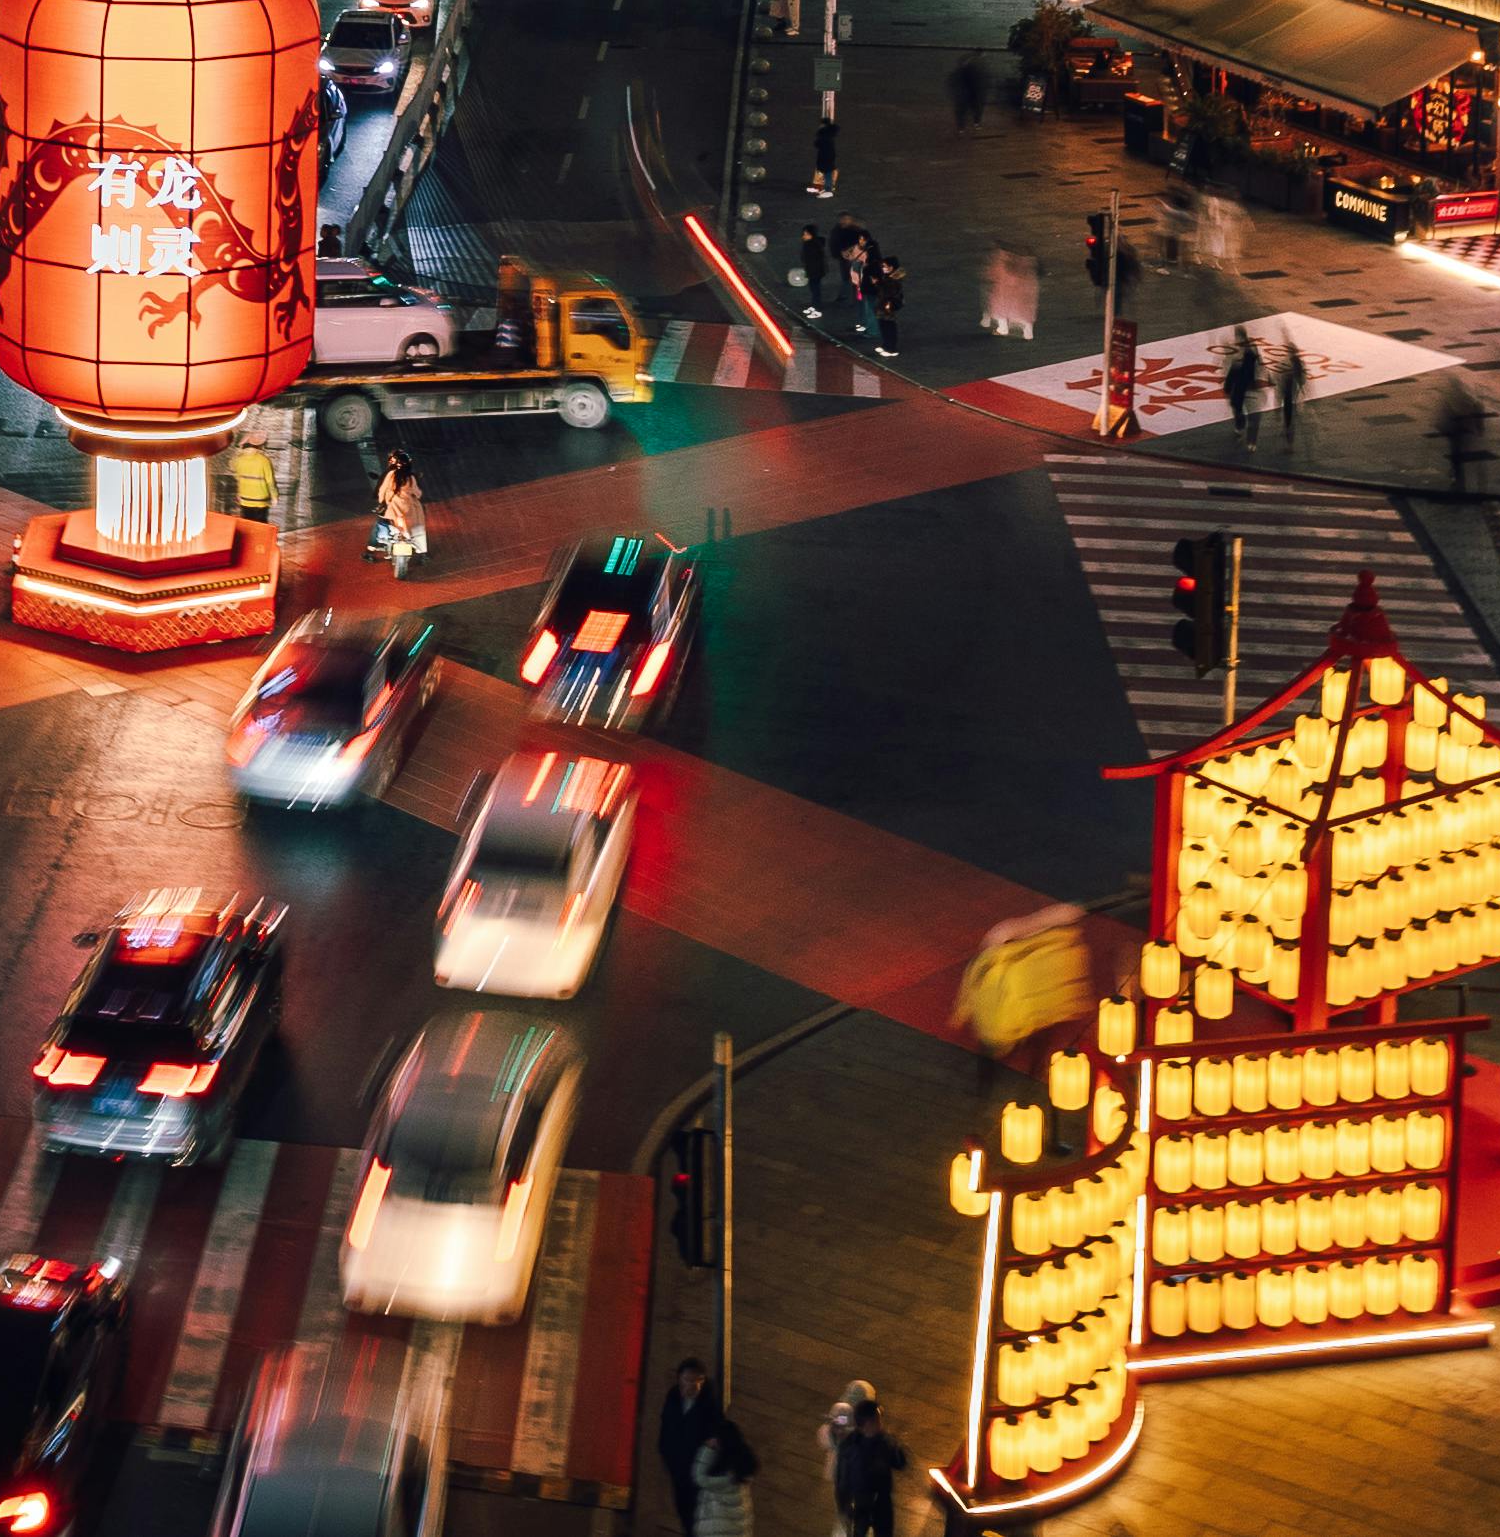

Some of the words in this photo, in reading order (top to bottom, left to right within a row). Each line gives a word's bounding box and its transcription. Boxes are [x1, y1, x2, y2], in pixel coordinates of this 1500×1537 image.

[87, 154, 203, 209] 有龙
[1335, 190, 1388, 223] COMMUNE
[85, 223, 201, 279] 则灵
